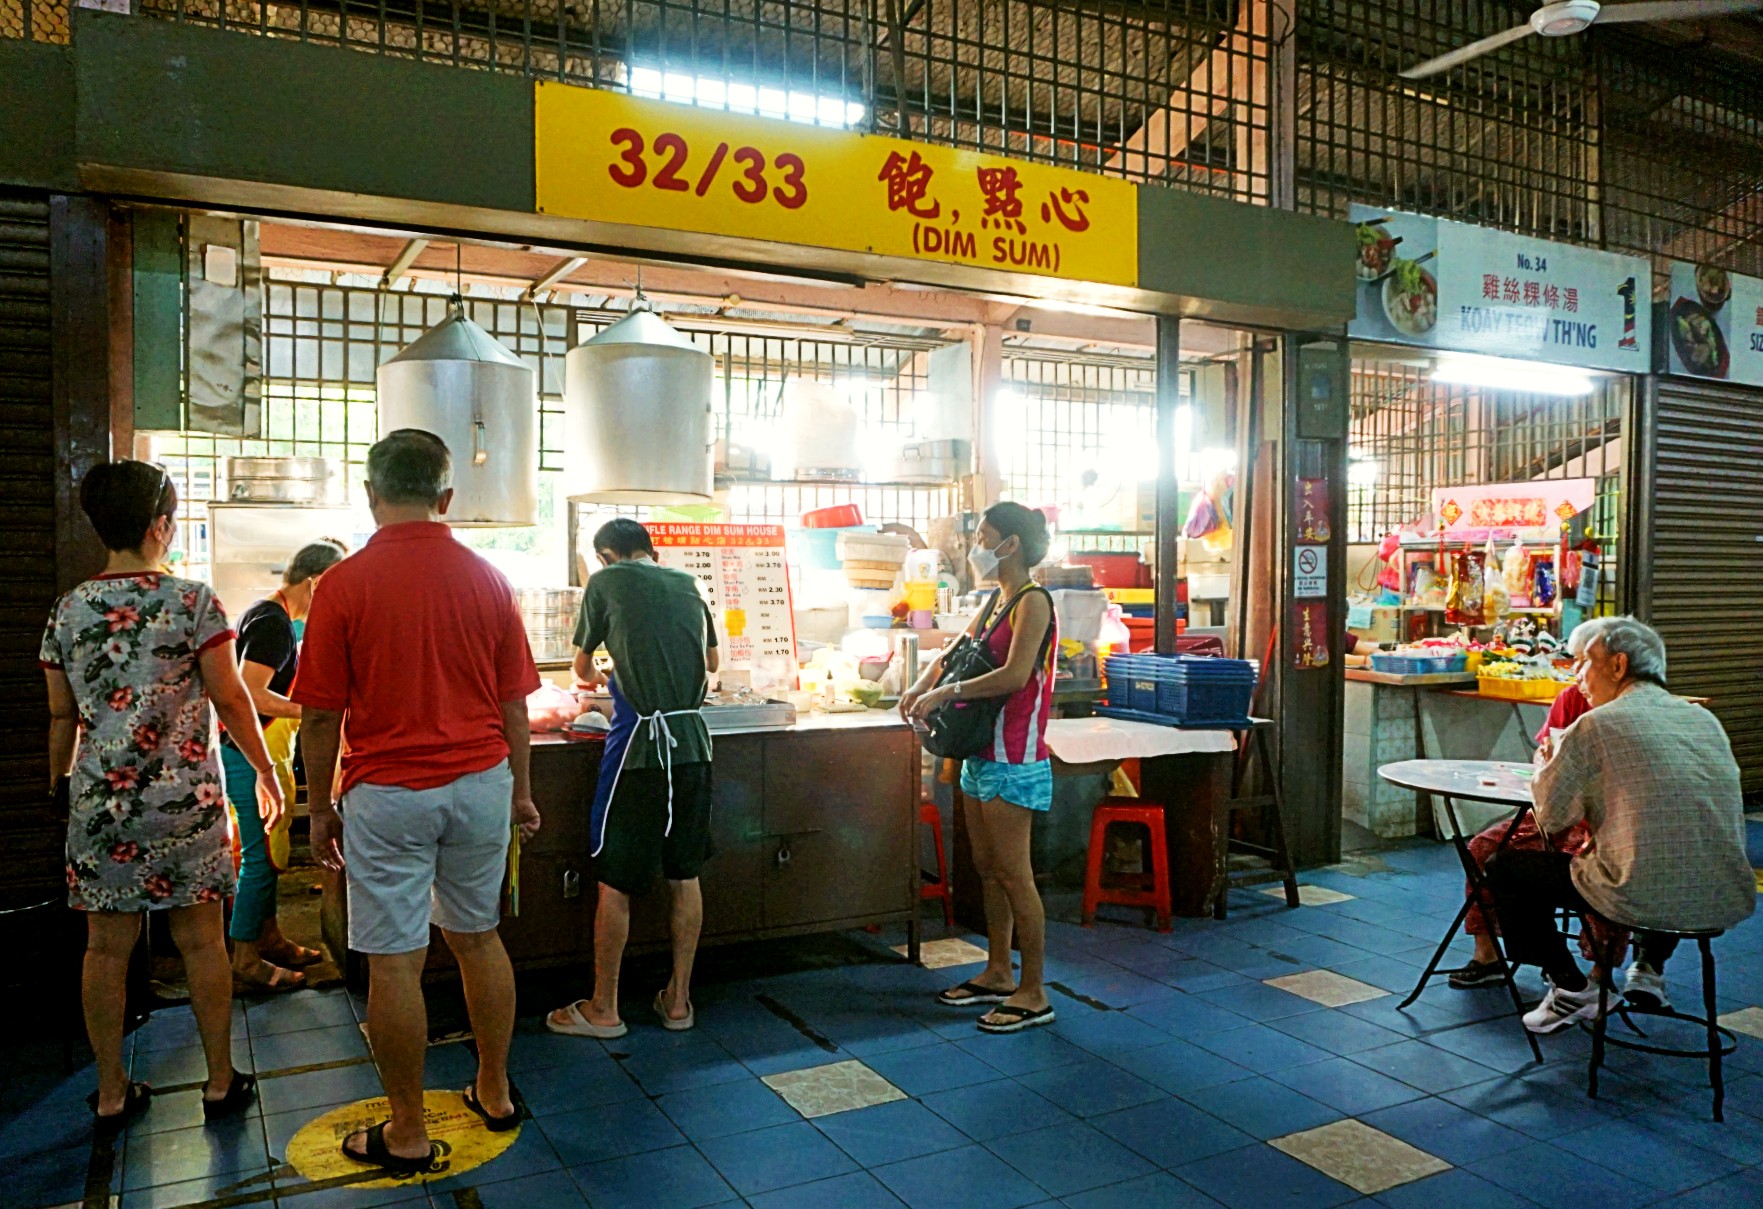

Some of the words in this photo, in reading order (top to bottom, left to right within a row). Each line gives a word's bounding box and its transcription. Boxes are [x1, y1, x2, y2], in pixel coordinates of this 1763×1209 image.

[608, 127, 808, 209] 32/33
[913, 222, 977, 259] (DIM
[992, 236, 1060, 273] SUM)
[1517, 253, 1533, 271] No.
[1535, 256, 1547, 273] 34
[1461, 305, 1502, 334] KOAY
[1553, 318, 1598, 349] TH'NG
[669, 525, 701, 535] RANGE
[704, 526, 721, 535] DIM
[723, 526, 744, 536] SUM
[747, 526, 778, 536] HOUSE
